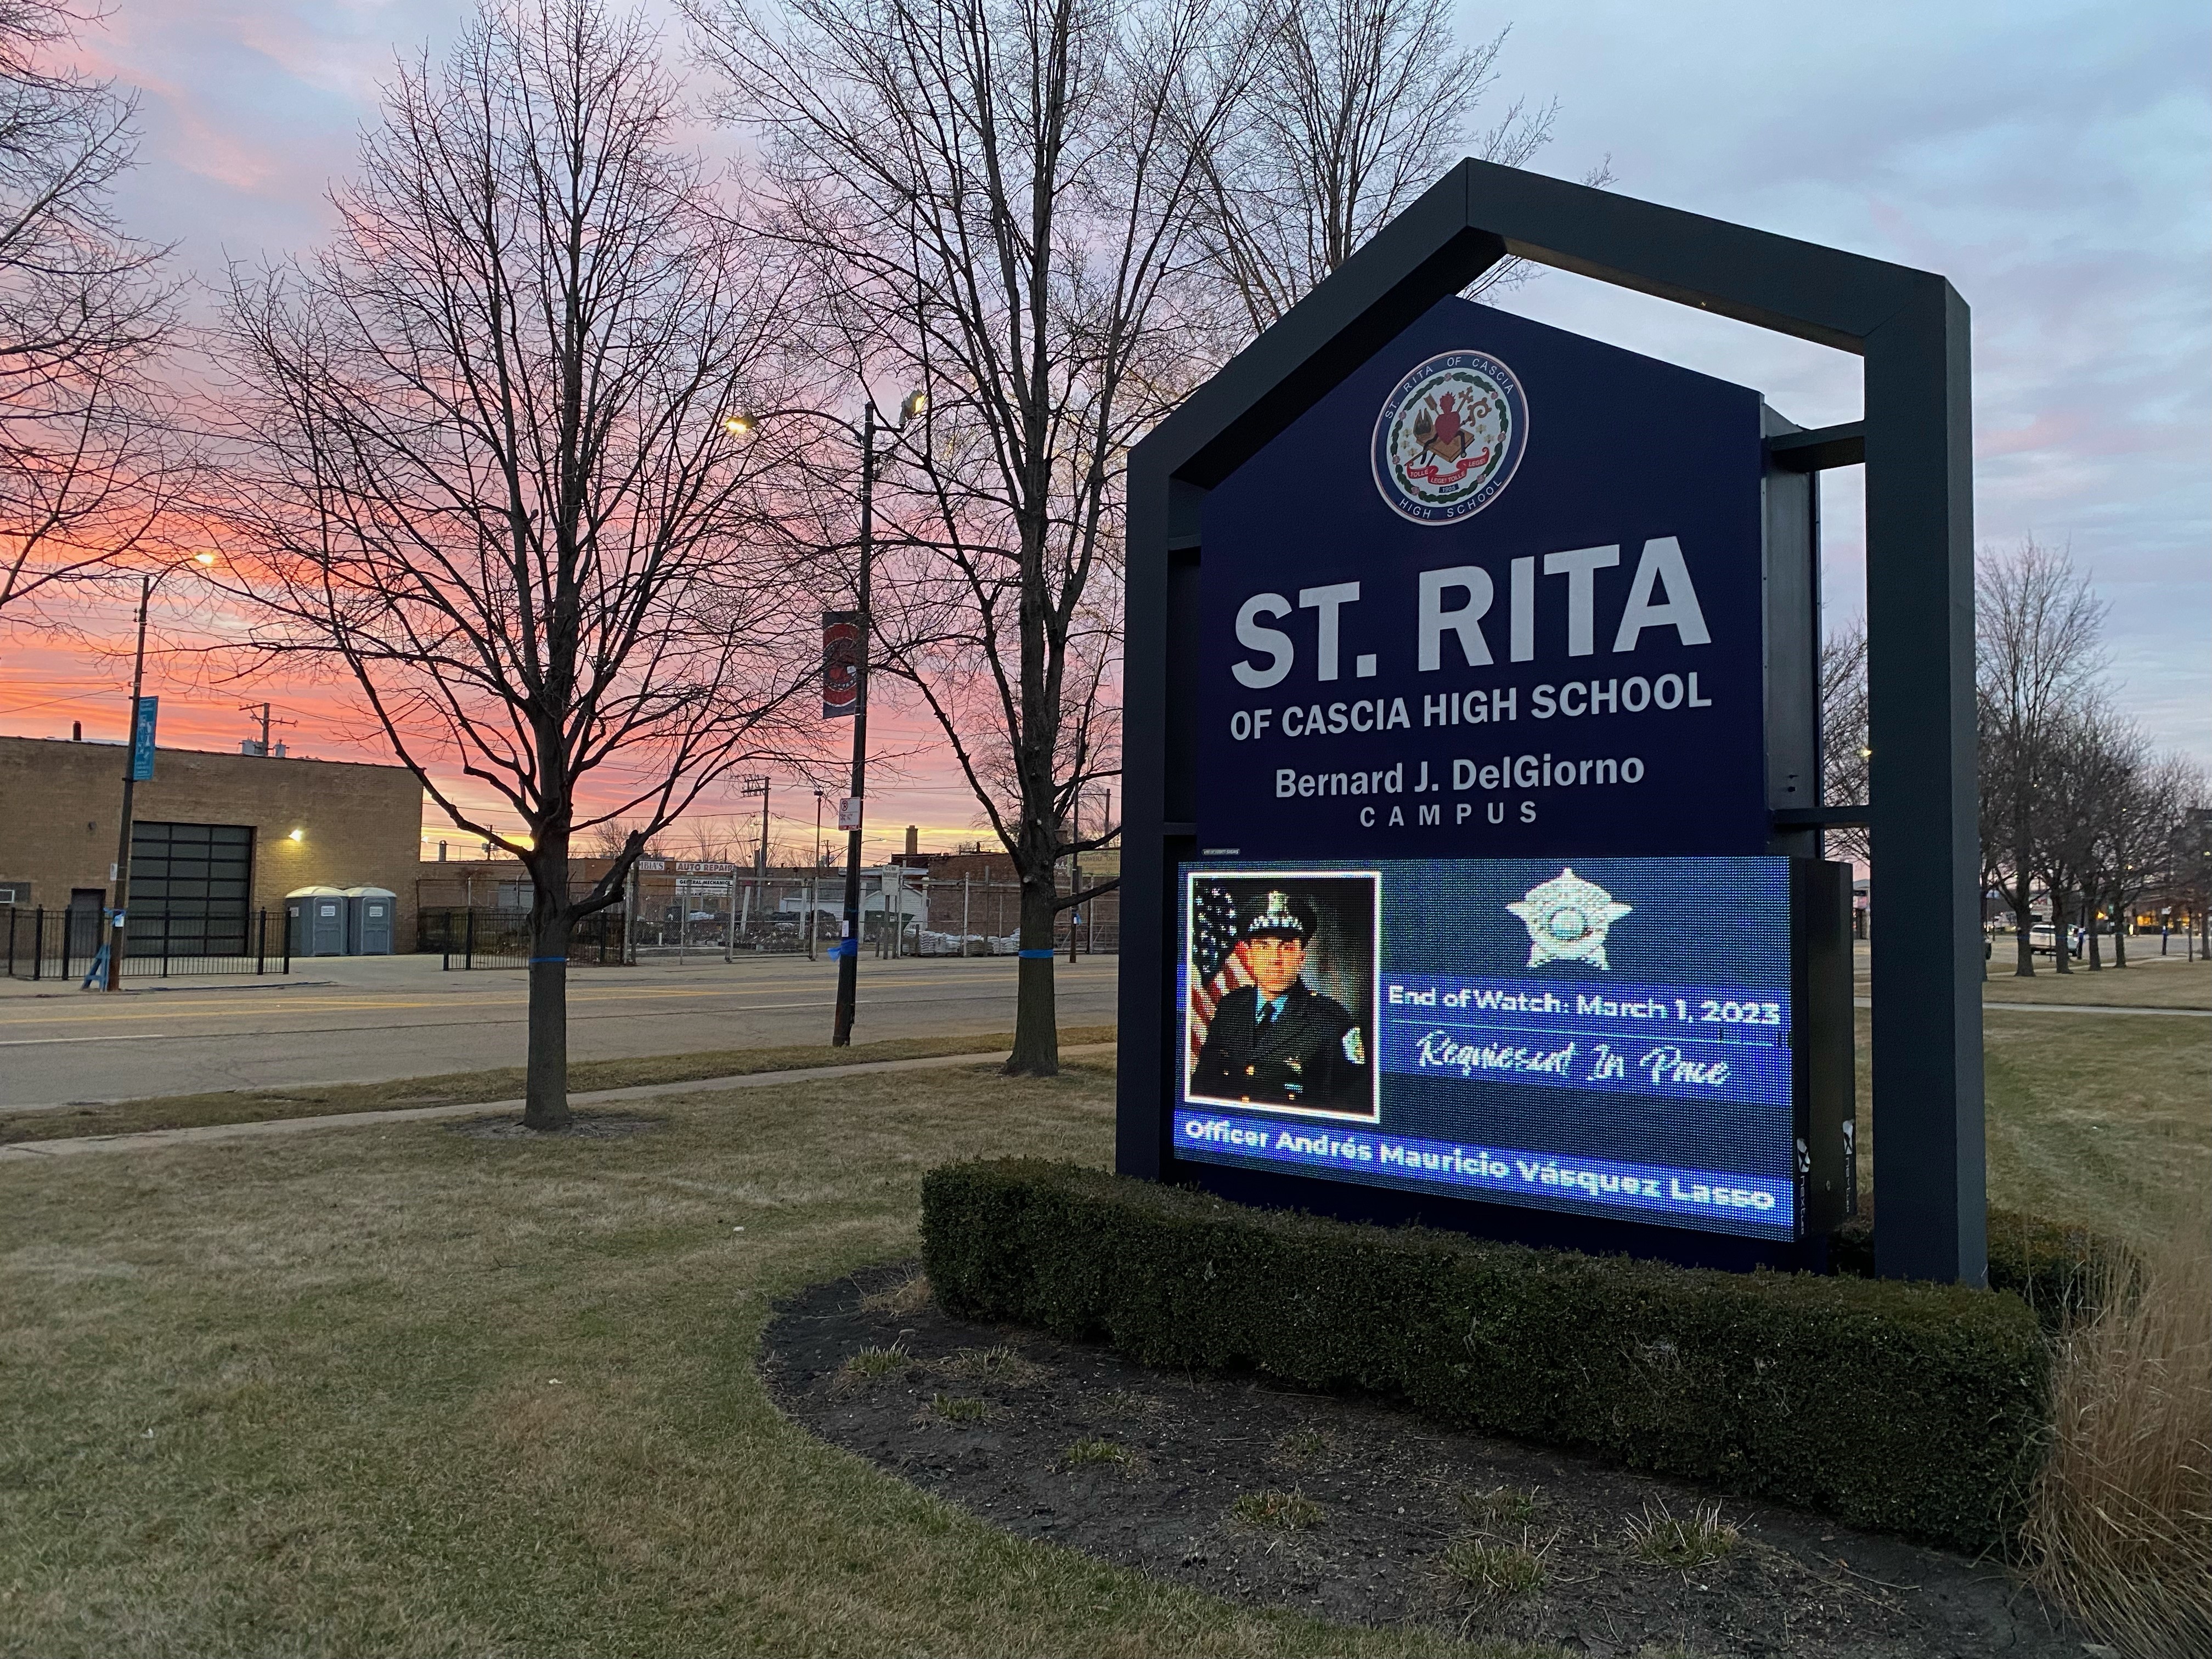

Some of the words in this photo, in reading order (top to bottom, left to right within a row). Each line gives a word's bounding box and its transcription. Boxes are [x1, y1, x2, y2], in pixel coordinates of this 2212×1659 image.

[1385, 400, 1400, 419] ST.
[1403, 365, 1434, 392] RITA
[1447, 357, 1462, 366] OF
[1472, 358, 1514, 394] CASCIA
[1410, 469, 1429, 477] TOLLE
[1448, 471, 1466, 482] TOLLE
[1400, 498, 1432, 519] HIGH
[1447, 480, 1502, 517] SCHOOL
[1231, 582, 1377, 689] ST.
[1418, 536, 1712, 672] RITA
[1231, 708, 1272, 741] OF
[1282, 697, 1411, 737] CASCIA
[1424, 687, 1517, 727] HIGH
[1531, 672, 1712, 719] SCHOOL
[1276, 762, 1403, 798] Bernard
[1414, 761, 1439, 792] J.
[1453, 753, 1644, 790] DelGiorno
[1360, 801, 1537, 827] CAMPUS
[677, 863, 701, 871] AUTO
[1389, 984, 1437, 1006] End
[1444, 988, 1471, 1008] of
[1472, 988, 1570, 1013] Watch:
[1577, 994, 1668, 1019] March
[1675, 998, 1694, 1023] 1,
[1701, 1000, 1780, 1025] 2023
[1586, 1043, 1625, 1081] In
[1185, 1120, 1269, 1148] Officer
[1276, 1131, 1372, 1161] Andrés
[1380, 1143, 1510, 1178] Mauricio
[1516, 1160, 1662, 1198] Vásquez
[1671, 1178, 1776, 1210] Lasso
